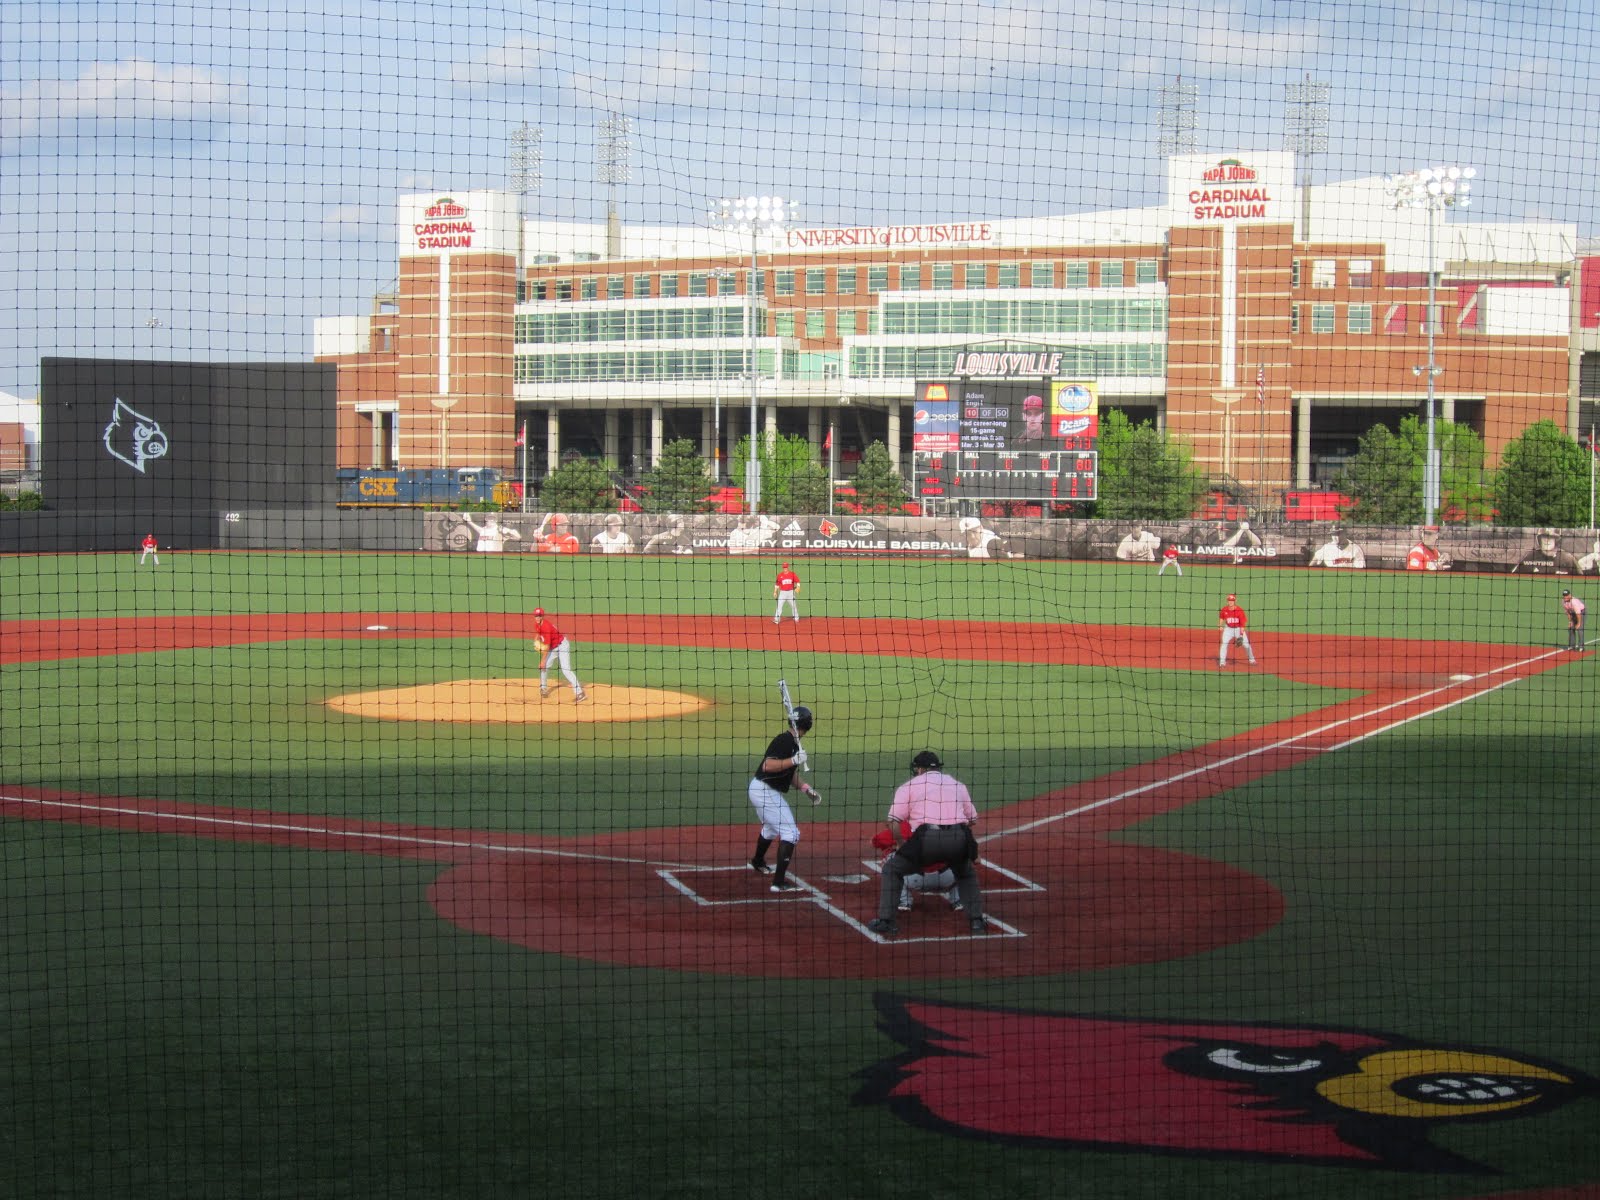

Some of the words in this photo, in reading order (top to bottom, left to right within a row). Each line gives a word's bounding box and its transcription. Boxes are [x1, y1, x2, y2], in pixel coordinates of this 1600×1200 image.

[1203, 167, 1225, 181] PAPA
[1189, 188, 1271, 203] CARDINAL
[425, 206, 441, 216] PAPA
[1194, 205, 1265, 219] STADIUM
[415, 222, 475, 235] CARDINAL
[787, 227, 880, 247] UNIVERSITY
[880, 226, 893, 246] of
[894, 224, 991, 243] LOUISVILLE
[418, 236, 471, 249] STADIUM
[954, 352, 1063, 376] LOUISVILLE
[1041, 459, 1049, 470] 0
[359, 477, 398, 496] CSX
[226, 513, 240, 522] 402
[692, 540, 777, 548] UNIVERSITY
[782, 540, 801, 548] OF
[806, 540, 886, 549] LOUISVILLE
[890, 541, 968, 550] BASEBALL
[1175, 545, 1192, 554] LL
[1196, 546, 1276, 556] AMERICANS
